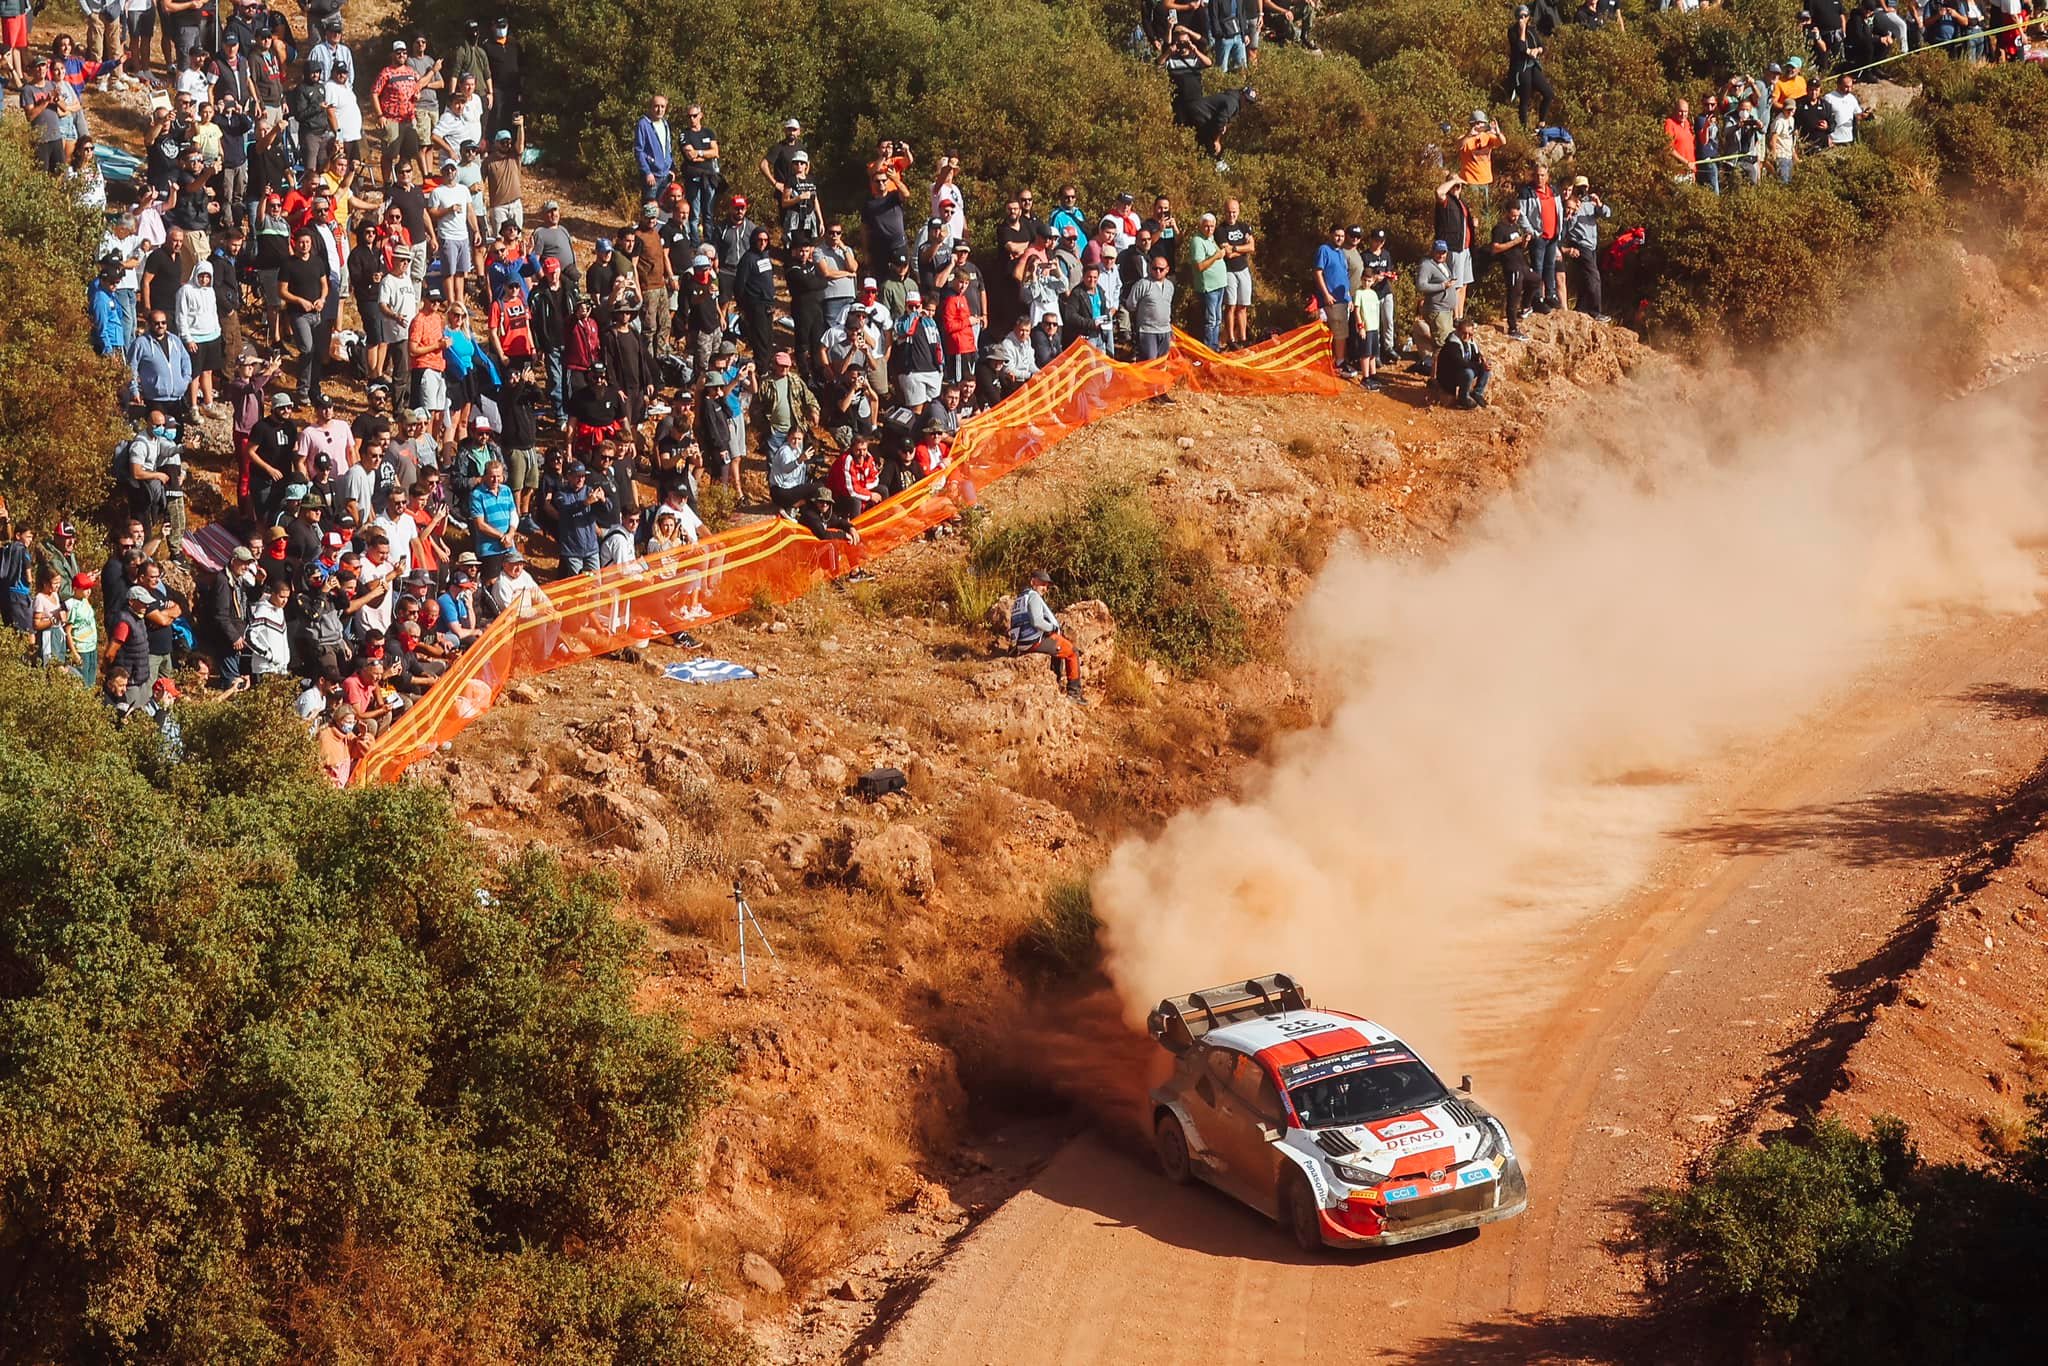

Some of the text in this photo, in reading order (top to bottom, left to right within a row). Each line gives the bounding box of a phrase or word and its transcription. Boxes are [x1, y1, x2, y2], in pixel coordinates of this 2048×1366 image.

[1386, 1130, 1445, 1151] DENSO
[1303, 1160, 1328, 1203] Panasonic
[1468, 1172, 1485, 1181] CCI
[1392, 1188, 1410, 1199] CCI
